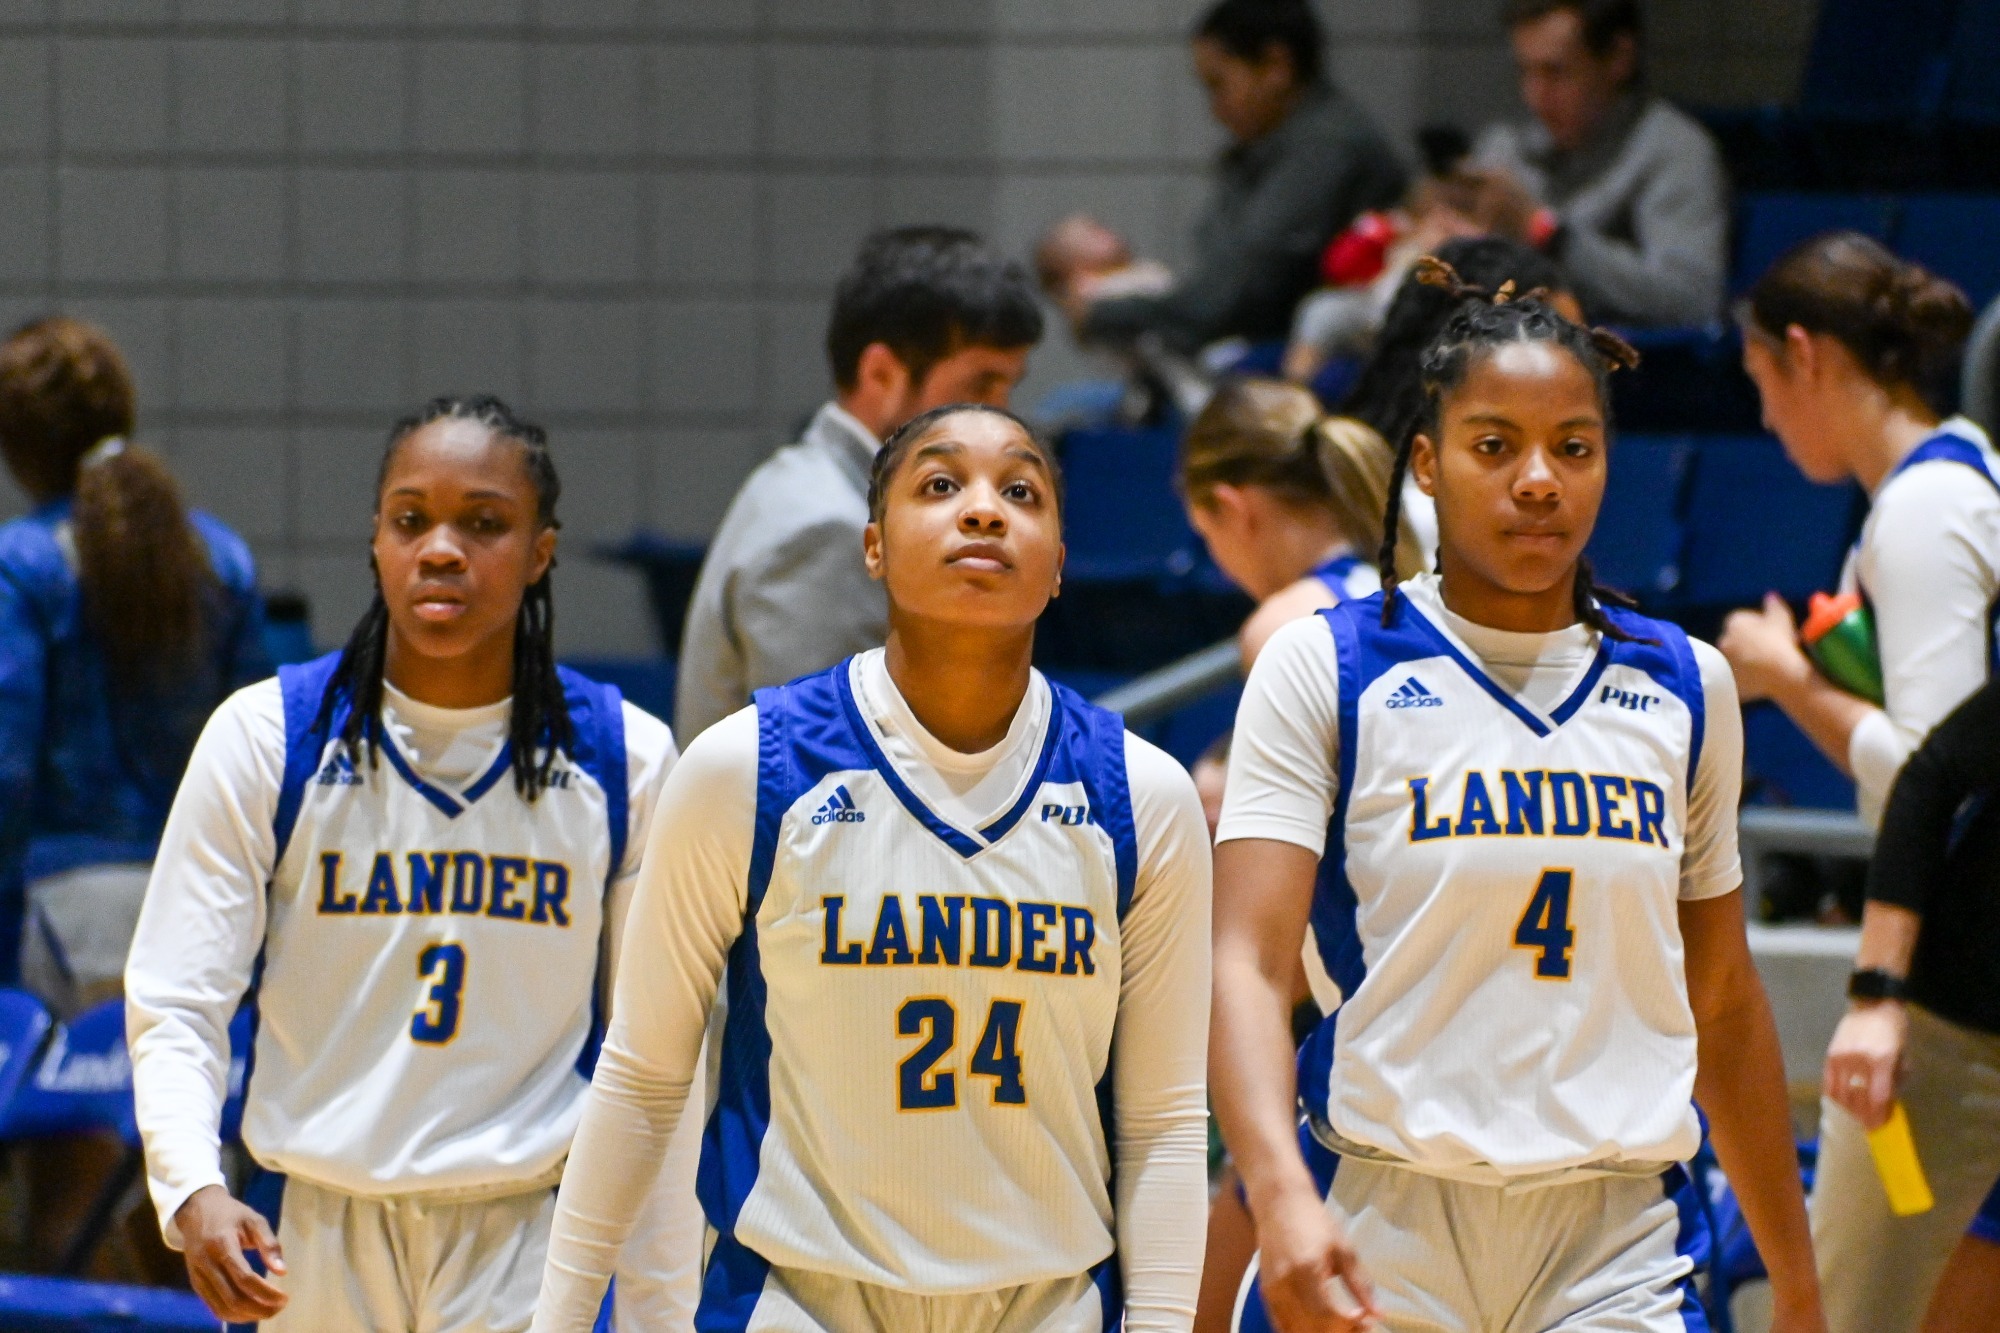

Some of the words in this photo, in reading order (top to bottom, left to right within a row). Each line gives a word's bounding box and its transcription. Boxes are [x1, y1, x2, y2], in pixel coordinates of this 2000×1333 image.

[1385, 697, 1443, 709] adidas
[1600, 685, 1660, 715] PBC
[811, 808, 866, 826] adidas
[1406, 768, 1670, 850] LANDER
[316, 850, 571, 929] LANDER
[1511, 866, 1576, 982] 4
[819, 893, 1098, 977] LANDER
[409, 940, 468, 1047] 3
[894, 994, 1030, 1113] 24
